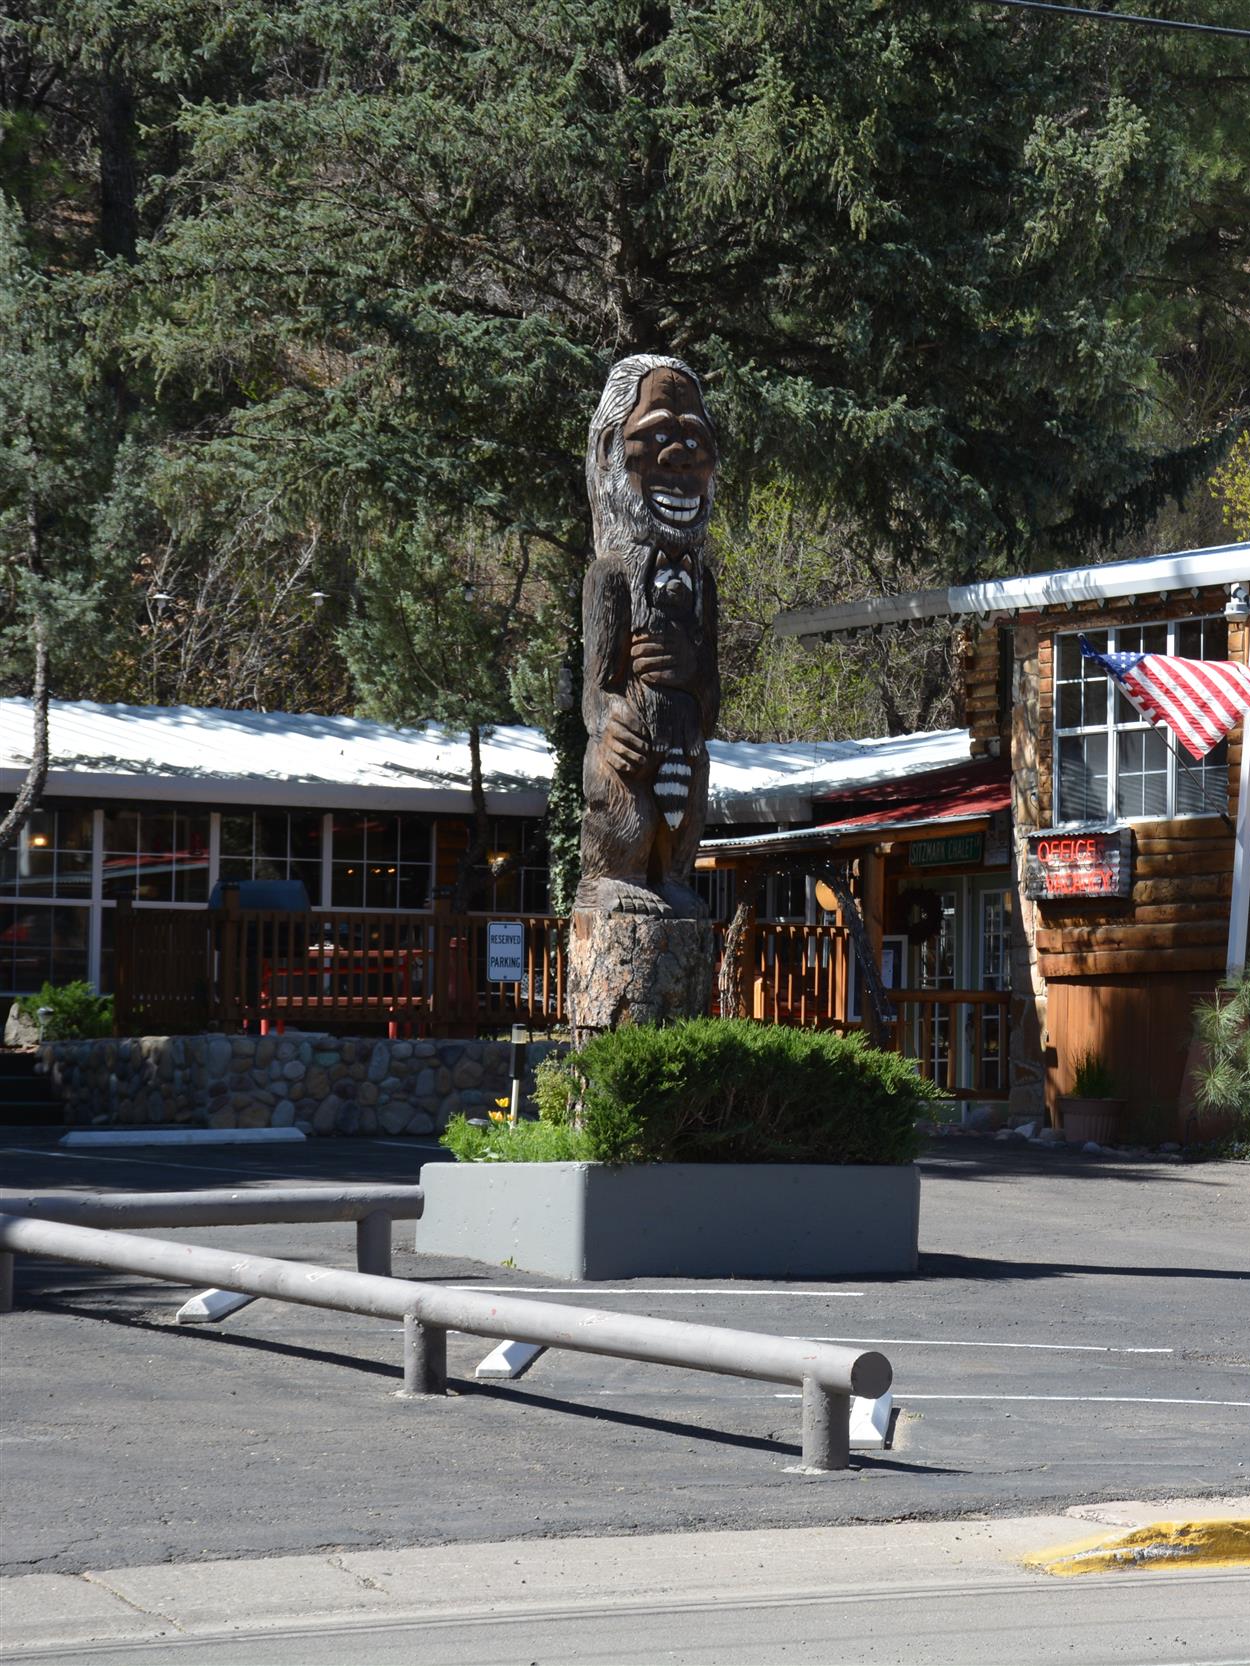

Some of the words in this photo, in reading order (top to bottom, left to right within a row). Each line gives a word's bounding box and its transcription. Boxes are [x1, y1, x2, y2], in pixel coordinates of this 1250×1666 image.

[911, 840, 946, 864] SITZMARK
[948, 837, 975, 860] CHALET
[1038, 840, 1096, 862] OFFICE
[1046, 870, 1112, 894] VACANCY
[490, 934, 521, 945] RESERVED
[490, 956, 521, 968] PARKING
